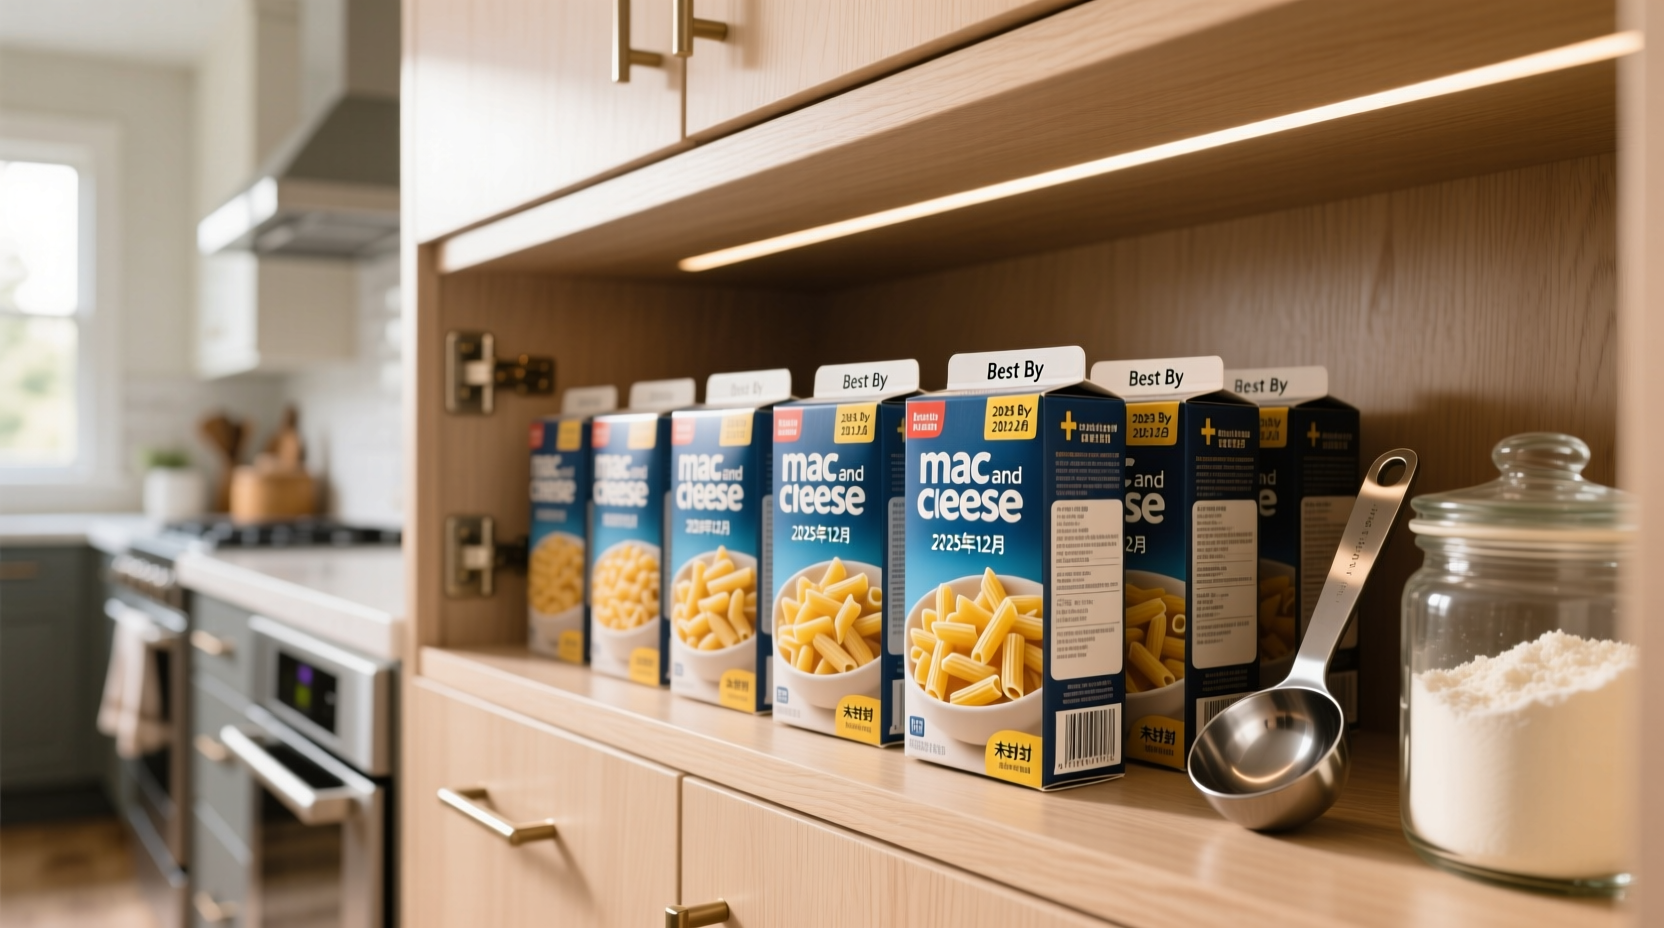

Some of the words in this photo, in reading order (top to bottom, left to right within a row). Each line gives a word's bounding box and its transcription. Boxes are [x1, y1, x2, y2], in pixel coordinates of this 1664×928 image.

[987, 362, 1019, 380] Best
[1024, 360, 1044, 382] By
[1129, 370, 1161, 386] Best
[1165, 369, 1184, 389] By
[843, 374, 868, 389] Best
[872, 372, 888, 391] By
[1234, 378, 1265, 394] Best
[1269, 377, 1288, 396] By
[1018, 404, 1032, 418] By
[678, 453, 724, 481] mac
[782, 452, 839, 482] mac
[839, 466, 864, 482] and
[920, 451, 991, 485] mac
[992, 466, 1022, 484] and
[1259, 469, 1277, 485] nd
[1134, 470, 1164, 488] and
[791, 524, 850, 544] 2025年12月
[931, 532, 1004, 555] 2025年12月
